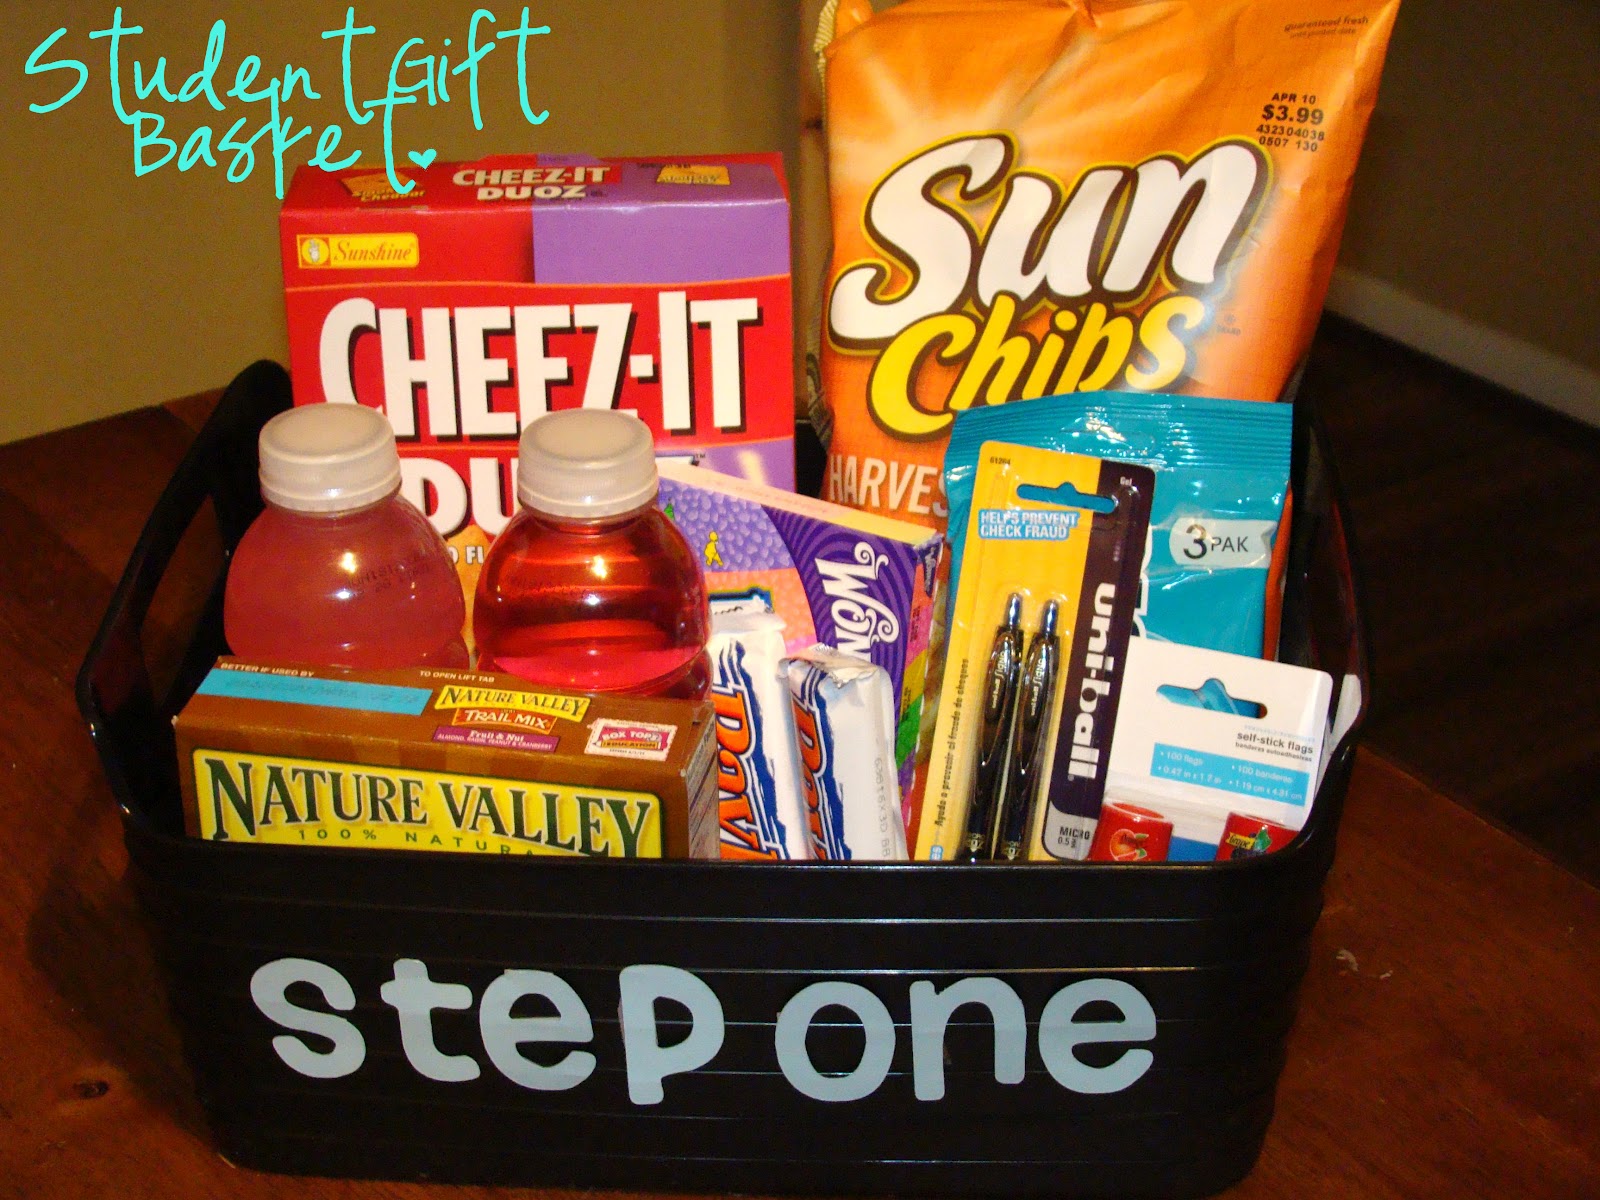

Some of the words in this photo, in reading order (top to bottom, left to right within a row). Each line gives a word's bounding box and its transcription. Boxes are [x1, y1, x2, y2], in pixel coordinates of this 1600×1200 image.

[1344, 15, 1369, 26] fresh
[1271, 92, 1297, 103] APR
[1302, 94, 1316, 105] 10
[1261, 103, 1324, 126] $3.99
[1256, 124, 1325, 141] 432304038
[1258, 136, 1289, 148] 0507
[1296, 141, 1318, 152] 130
[452, 167, 611, 186] CHEEZ-IT
[476, 185, 587, 200] DUOZ
[827, 134, 1266, 346] Sun
[334, 240, 412, 262] Sunshine
[319, 291, 760, 440] CHEEZ-IT
[869, 291, 1210, 436] Chips
[1021, 512, 1078, 526] PREVENT
[980, 525, 1021, 538] CHECK
[1025, 525, 1067, 538] FRAUD
[1183, 524, 1208, 560] 3
[1211, 536, 1249, 553] PAK
[220, 663, 260, 672] BETTER
[261, 666, 271, 674] IF
[272, 668, 299, 677] USED
[300, 670, 315, 678] BY
[420, 670, 431, 678] TO
[432, 671, 458, 680] OPEN
[459, 673, 476, 682] LIFT
[478, 675, 495, 683] TAB
[1068, 582, 1116, 779] uni-ball
[440, 687, 515, 705] NATURE
[517, 693, 586, 717] VALLEY
[464, 709, 513, 723] TRAIL
[514, 712, 549, 730] MIX
[505, 732, 525, 742] Nut
[601, 731, 627, 741] BOX
[1236, 731, 1285, 749] self-stick
[1287, 739, 1314, 755] flags
[203, 756, 428, 842] NATURE
[436, 780, 654, 859] VALLEY
[298, 828, 377, 841] 100%
[248, 957, 725, 1106] step
[774, 976, 1157, 1103] one
